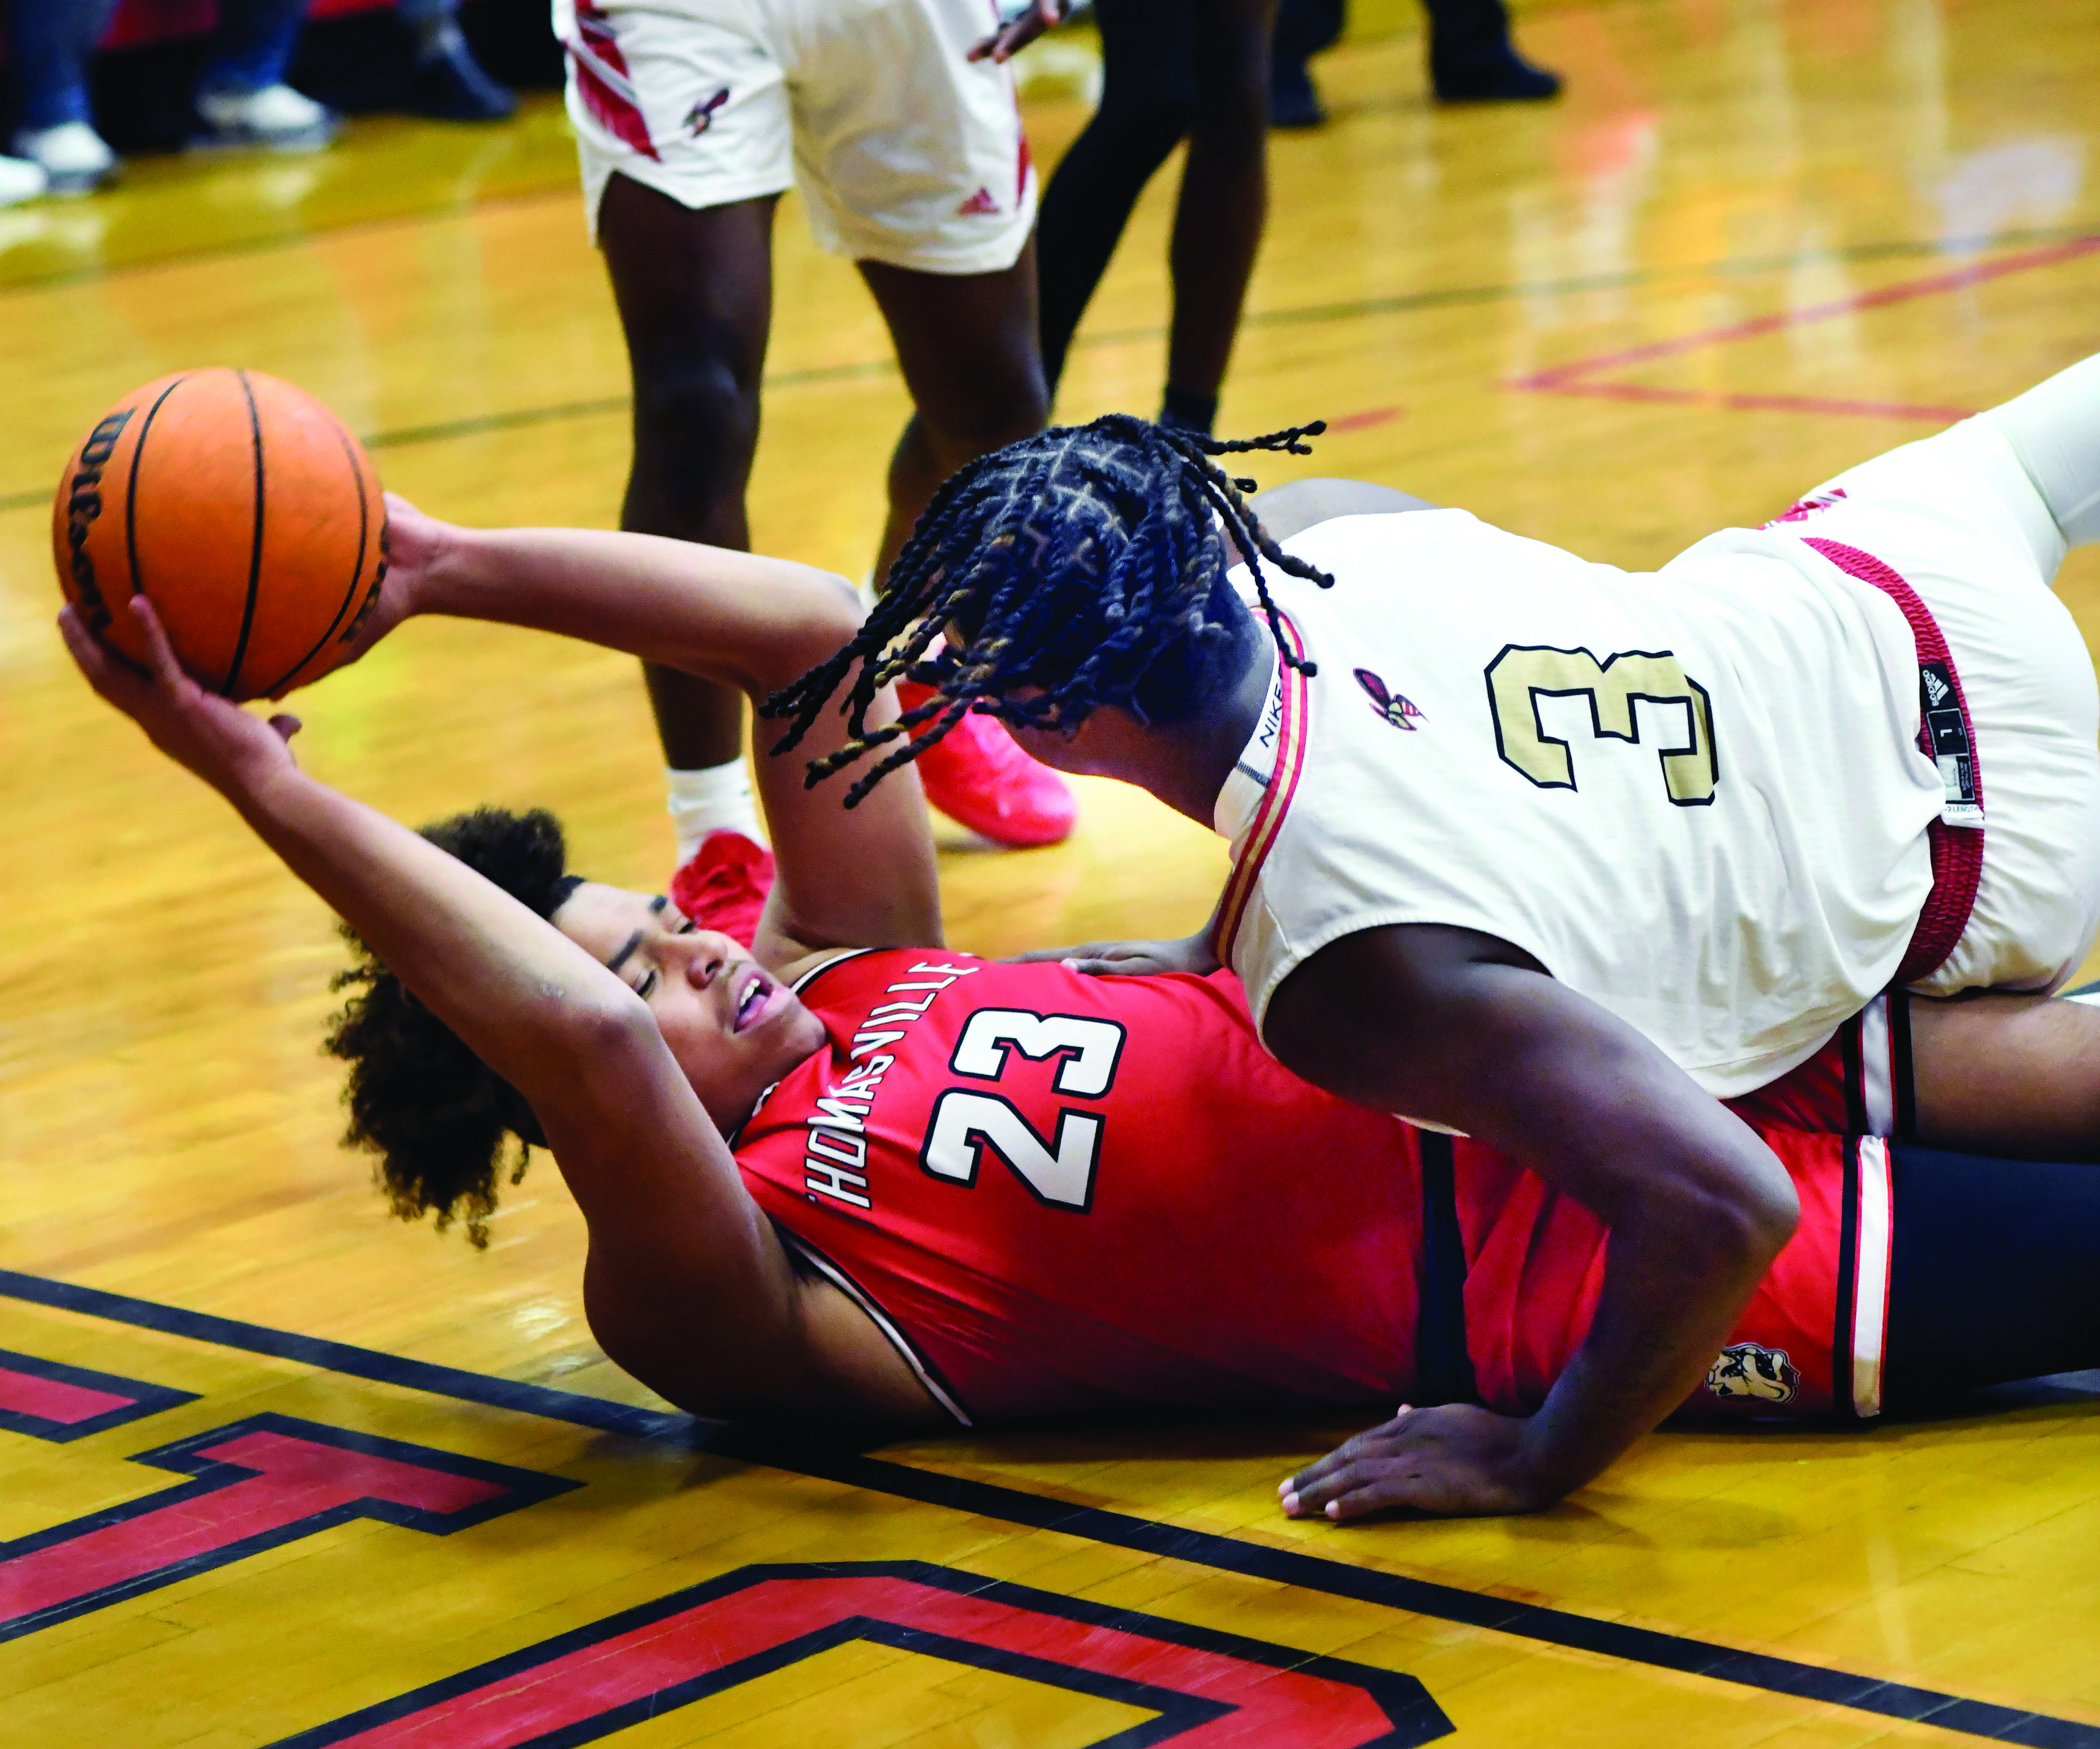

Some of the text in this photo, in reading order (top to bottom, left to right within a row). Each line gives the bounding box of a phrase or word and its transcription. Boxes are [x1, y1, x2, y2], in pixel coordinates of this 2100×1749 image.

[1259, 683, 1283, 748] NIKE
[1483, 644, 1719, 807] 3
[1922, 669, 1939, 707] adidas
[1940, 729, 1953, 737] L
[804, 961, 980, 1209] HOMASVILLE
[918, 1006, 1128, 1216] 23
